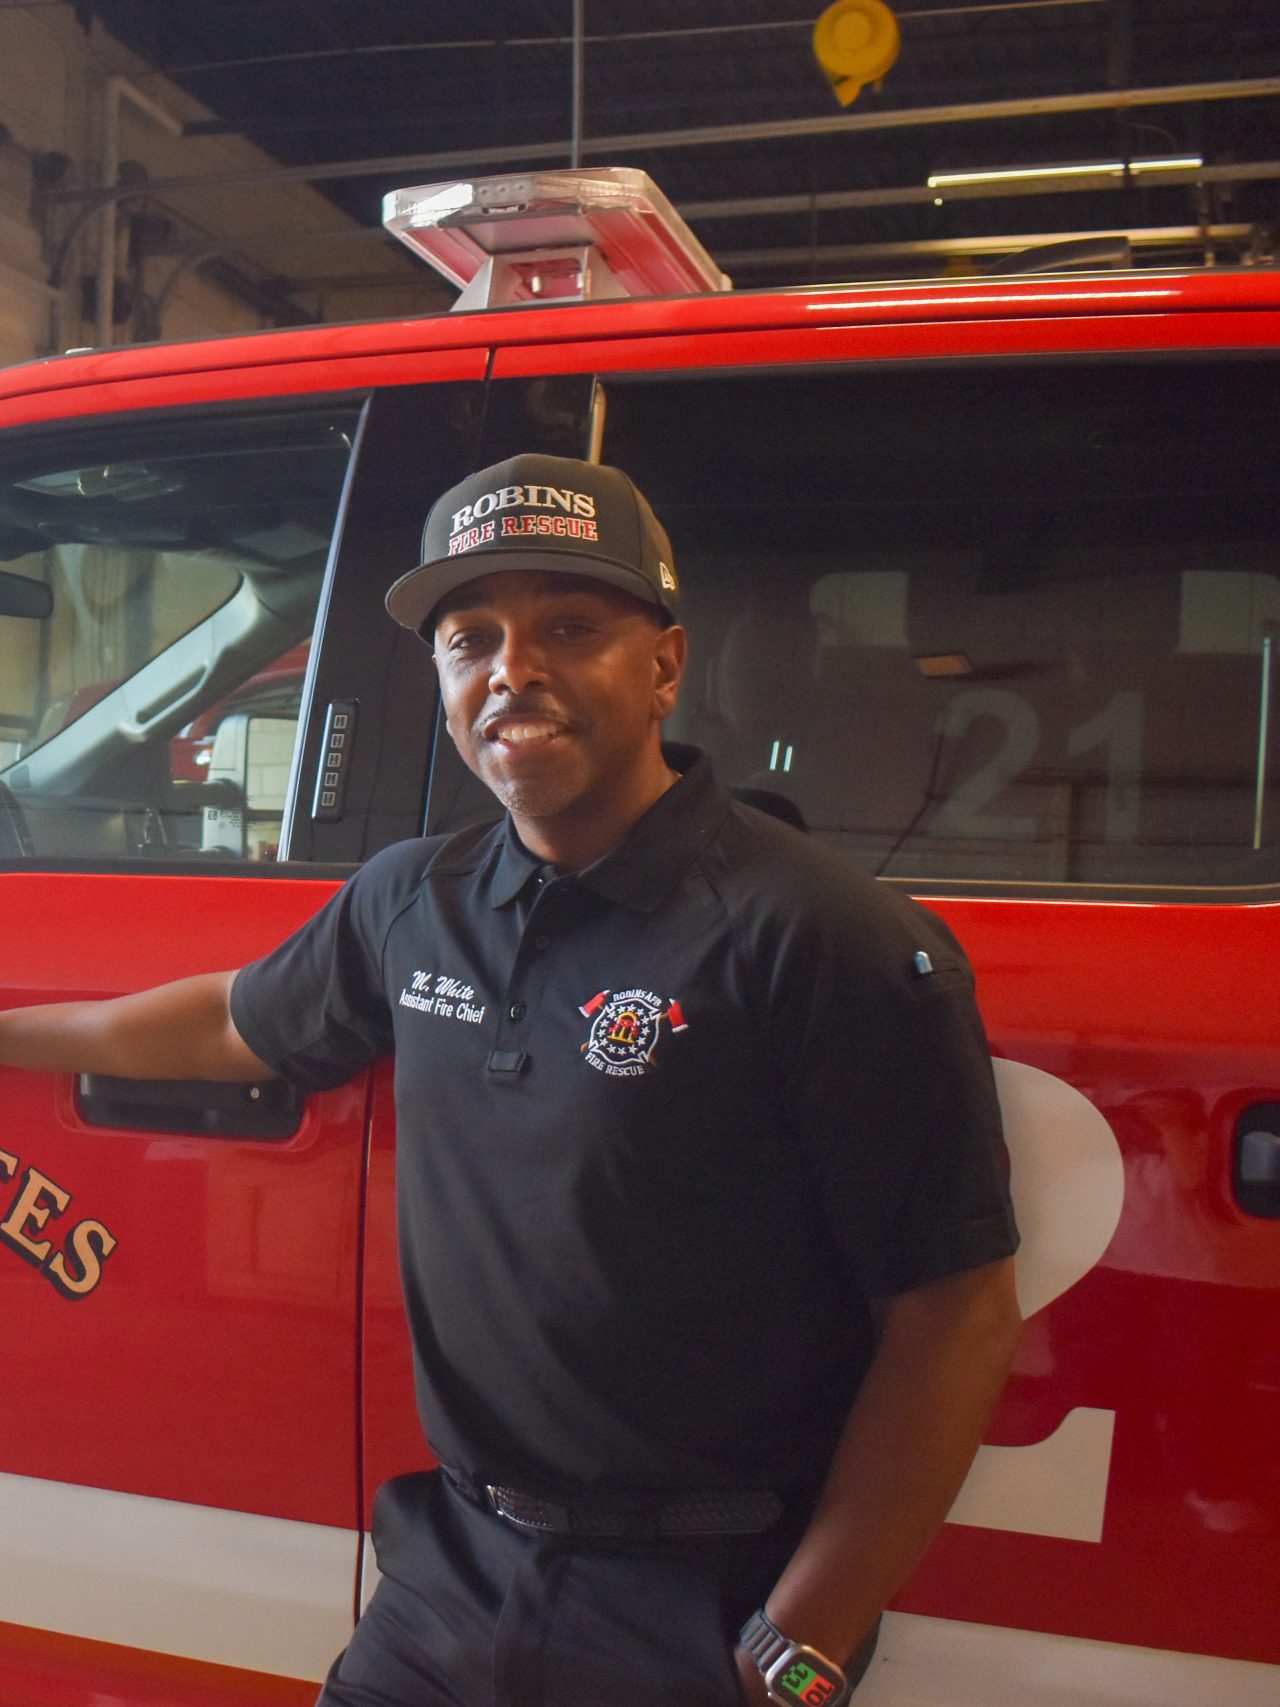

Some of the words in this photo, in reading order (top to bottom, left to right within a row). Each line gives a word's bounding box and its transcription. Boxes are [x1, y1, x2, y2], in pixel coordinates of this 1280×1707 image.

[449, 485, 596, 537] ROBINS
[448, 520, 495, 556] FIRE
[501, 515, 599, 541] RESCUE
[411, 970, 432, 993] M.
[434, 975, 475, 1001] White
[399, 988, 435, 1013] Assistant
[434, 998, 454, 1017] Fire
[456, 1002, 486, 1024] Chief
[585, 1052, 606, 1071] FIRE
[605, 1064, 645, 1077] RESCUE
